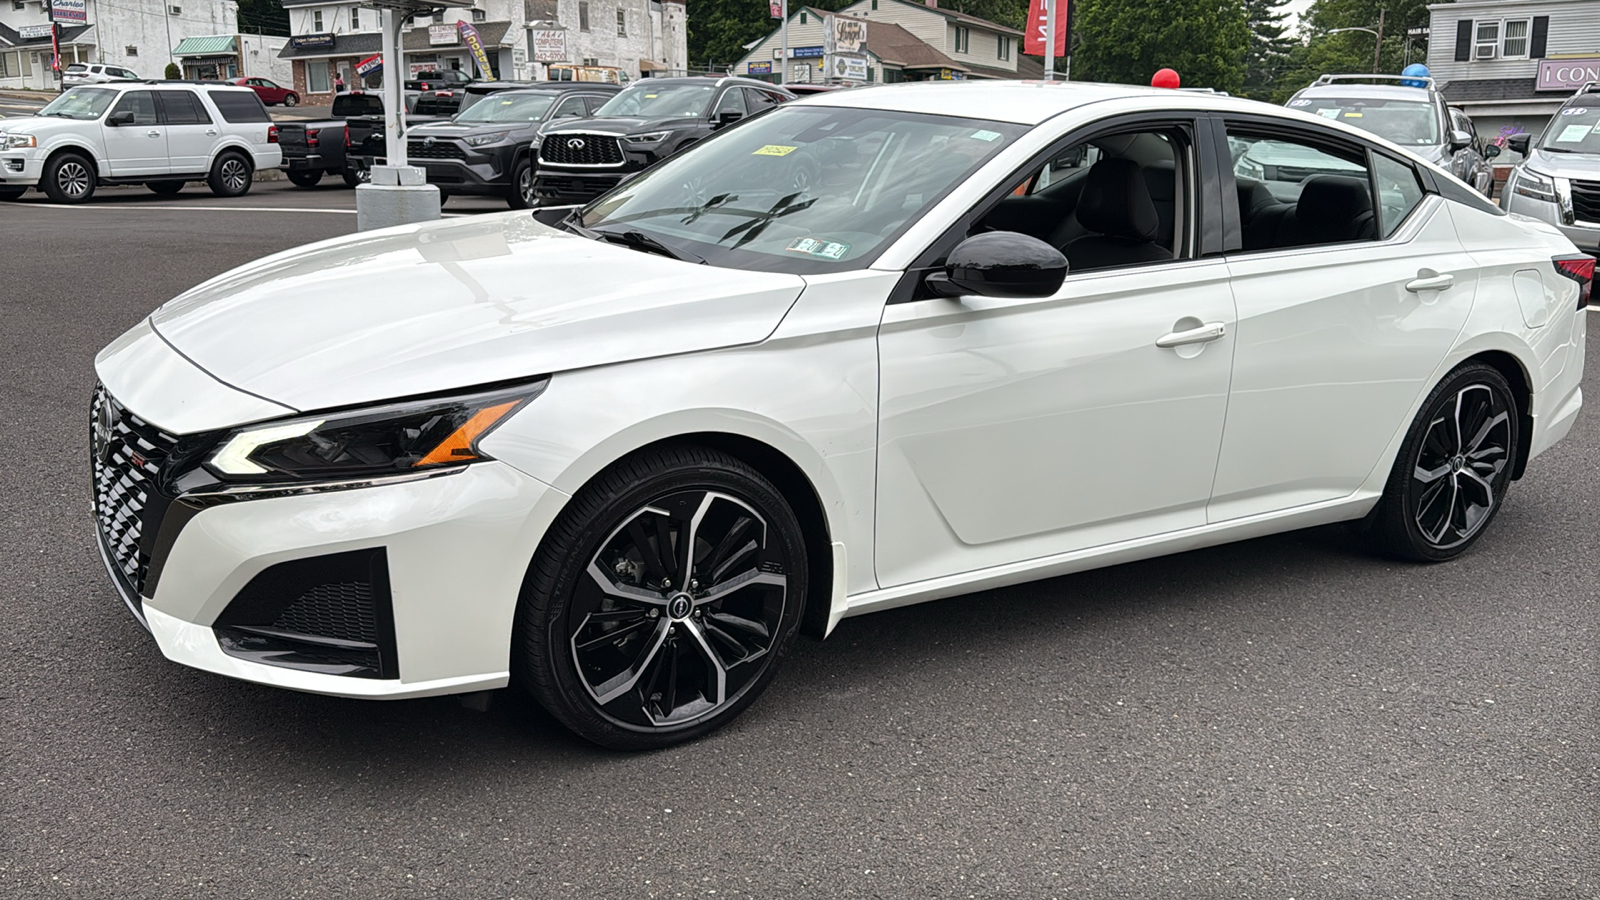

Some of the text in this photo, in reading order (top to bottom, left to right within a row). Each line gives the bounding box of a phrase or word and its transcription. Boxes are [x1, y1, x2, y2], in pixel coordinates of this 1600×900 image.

[535, 38, 564, 46] COMPUTERS
[1545, 66, 1551, 82] i
[761, 560, 783, 573] SR
